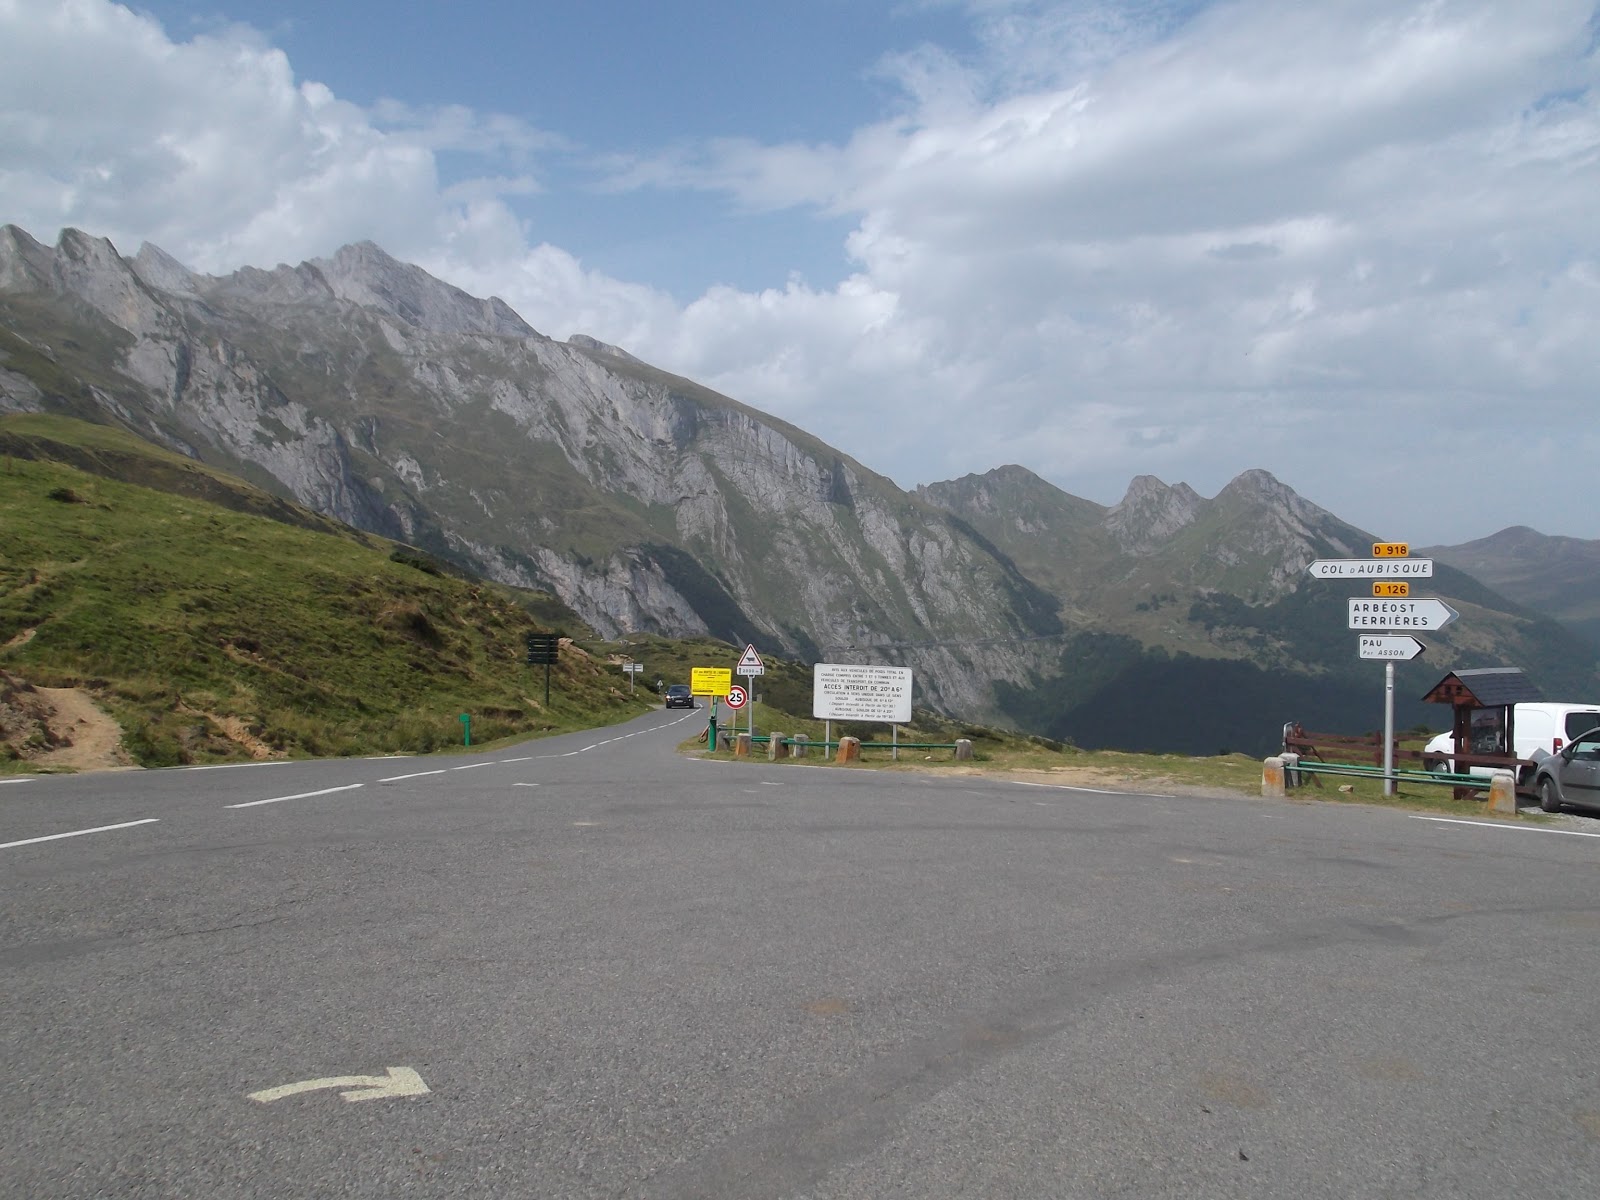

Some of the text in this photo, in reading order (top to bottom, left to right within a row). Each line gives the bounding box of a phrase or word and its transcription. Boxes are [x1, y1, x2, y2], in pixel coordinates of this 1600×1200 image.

[1387, 546, 1406, 554] 918
[1354, 602, 1415, 612] ARBÉOST
[1354, 615, 1428, 625] FERRIÈRES
[730, 693, 742, 702] 25
